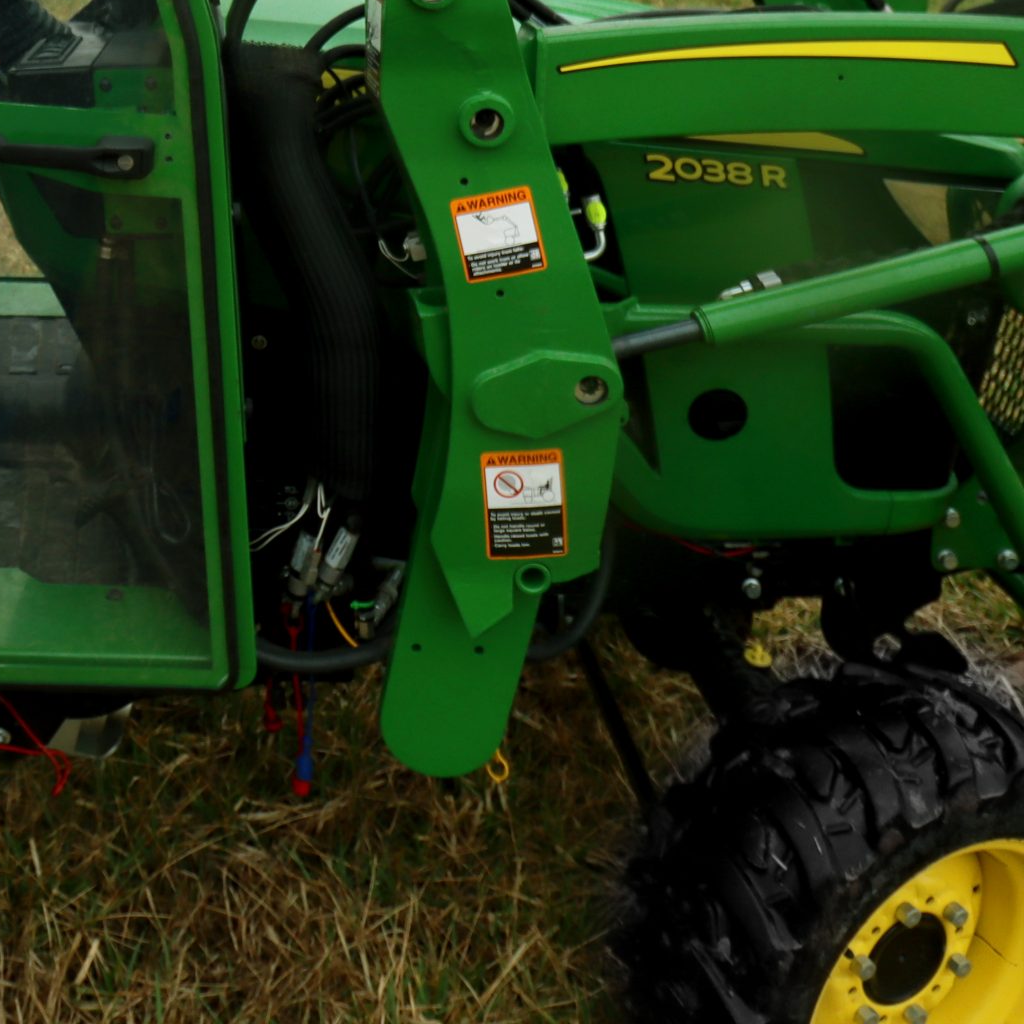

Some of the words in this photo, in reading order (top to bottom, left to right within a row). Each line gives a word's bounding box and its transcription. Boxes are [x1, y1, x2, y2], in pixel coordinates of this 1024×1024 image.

[646, 153, 754, 185] 2038
[760, 164, 787, 188] R
[466, 190, 527, 210] WARNING
[497, 452, 557, 465] WARNING
